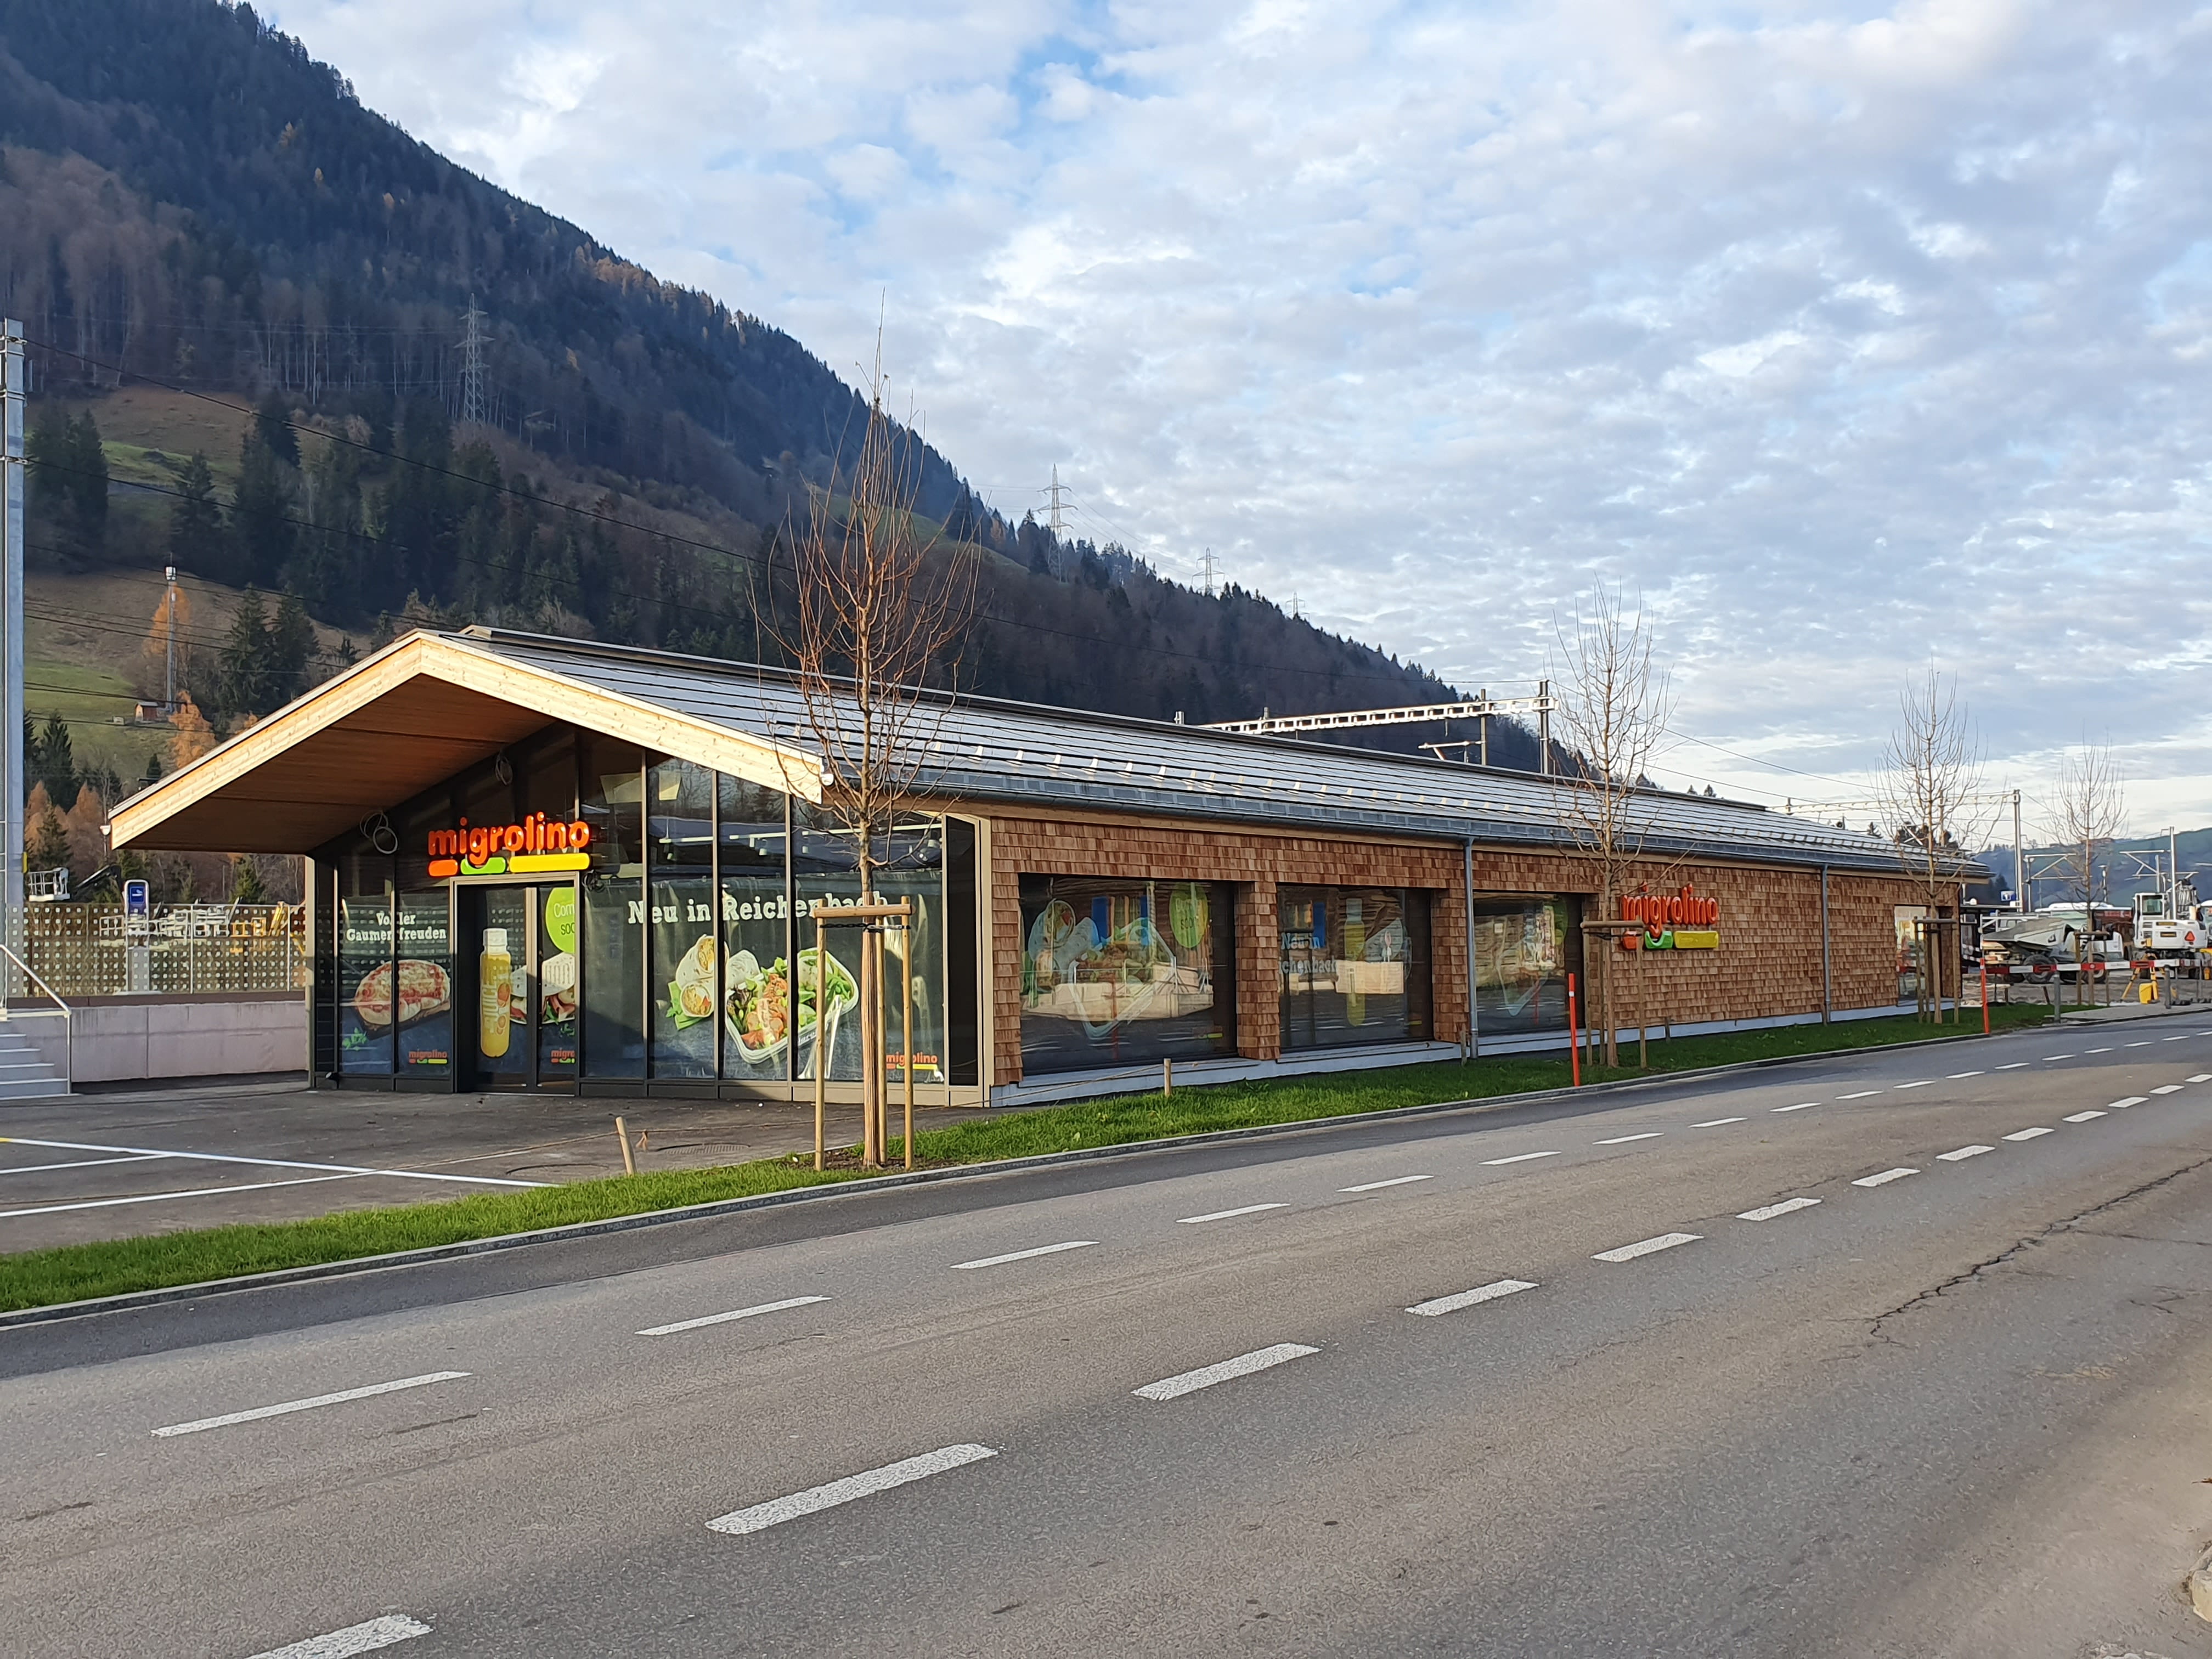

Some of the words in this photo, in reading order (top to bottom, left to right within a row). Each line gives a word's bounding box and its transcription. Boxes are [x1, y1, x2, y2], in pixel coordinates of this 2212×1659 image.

[428, 812, 590, 865] migrolino
[376, 912, 416, 926] Voler
[628, 900, 678, 924] Neu
[687, 899, 711, 922] in
[1621, 881, 1718, 938] migrolino
[409, 1048, 447, 1060] migrolino
[886, 1051, 938, 1065] migolino
